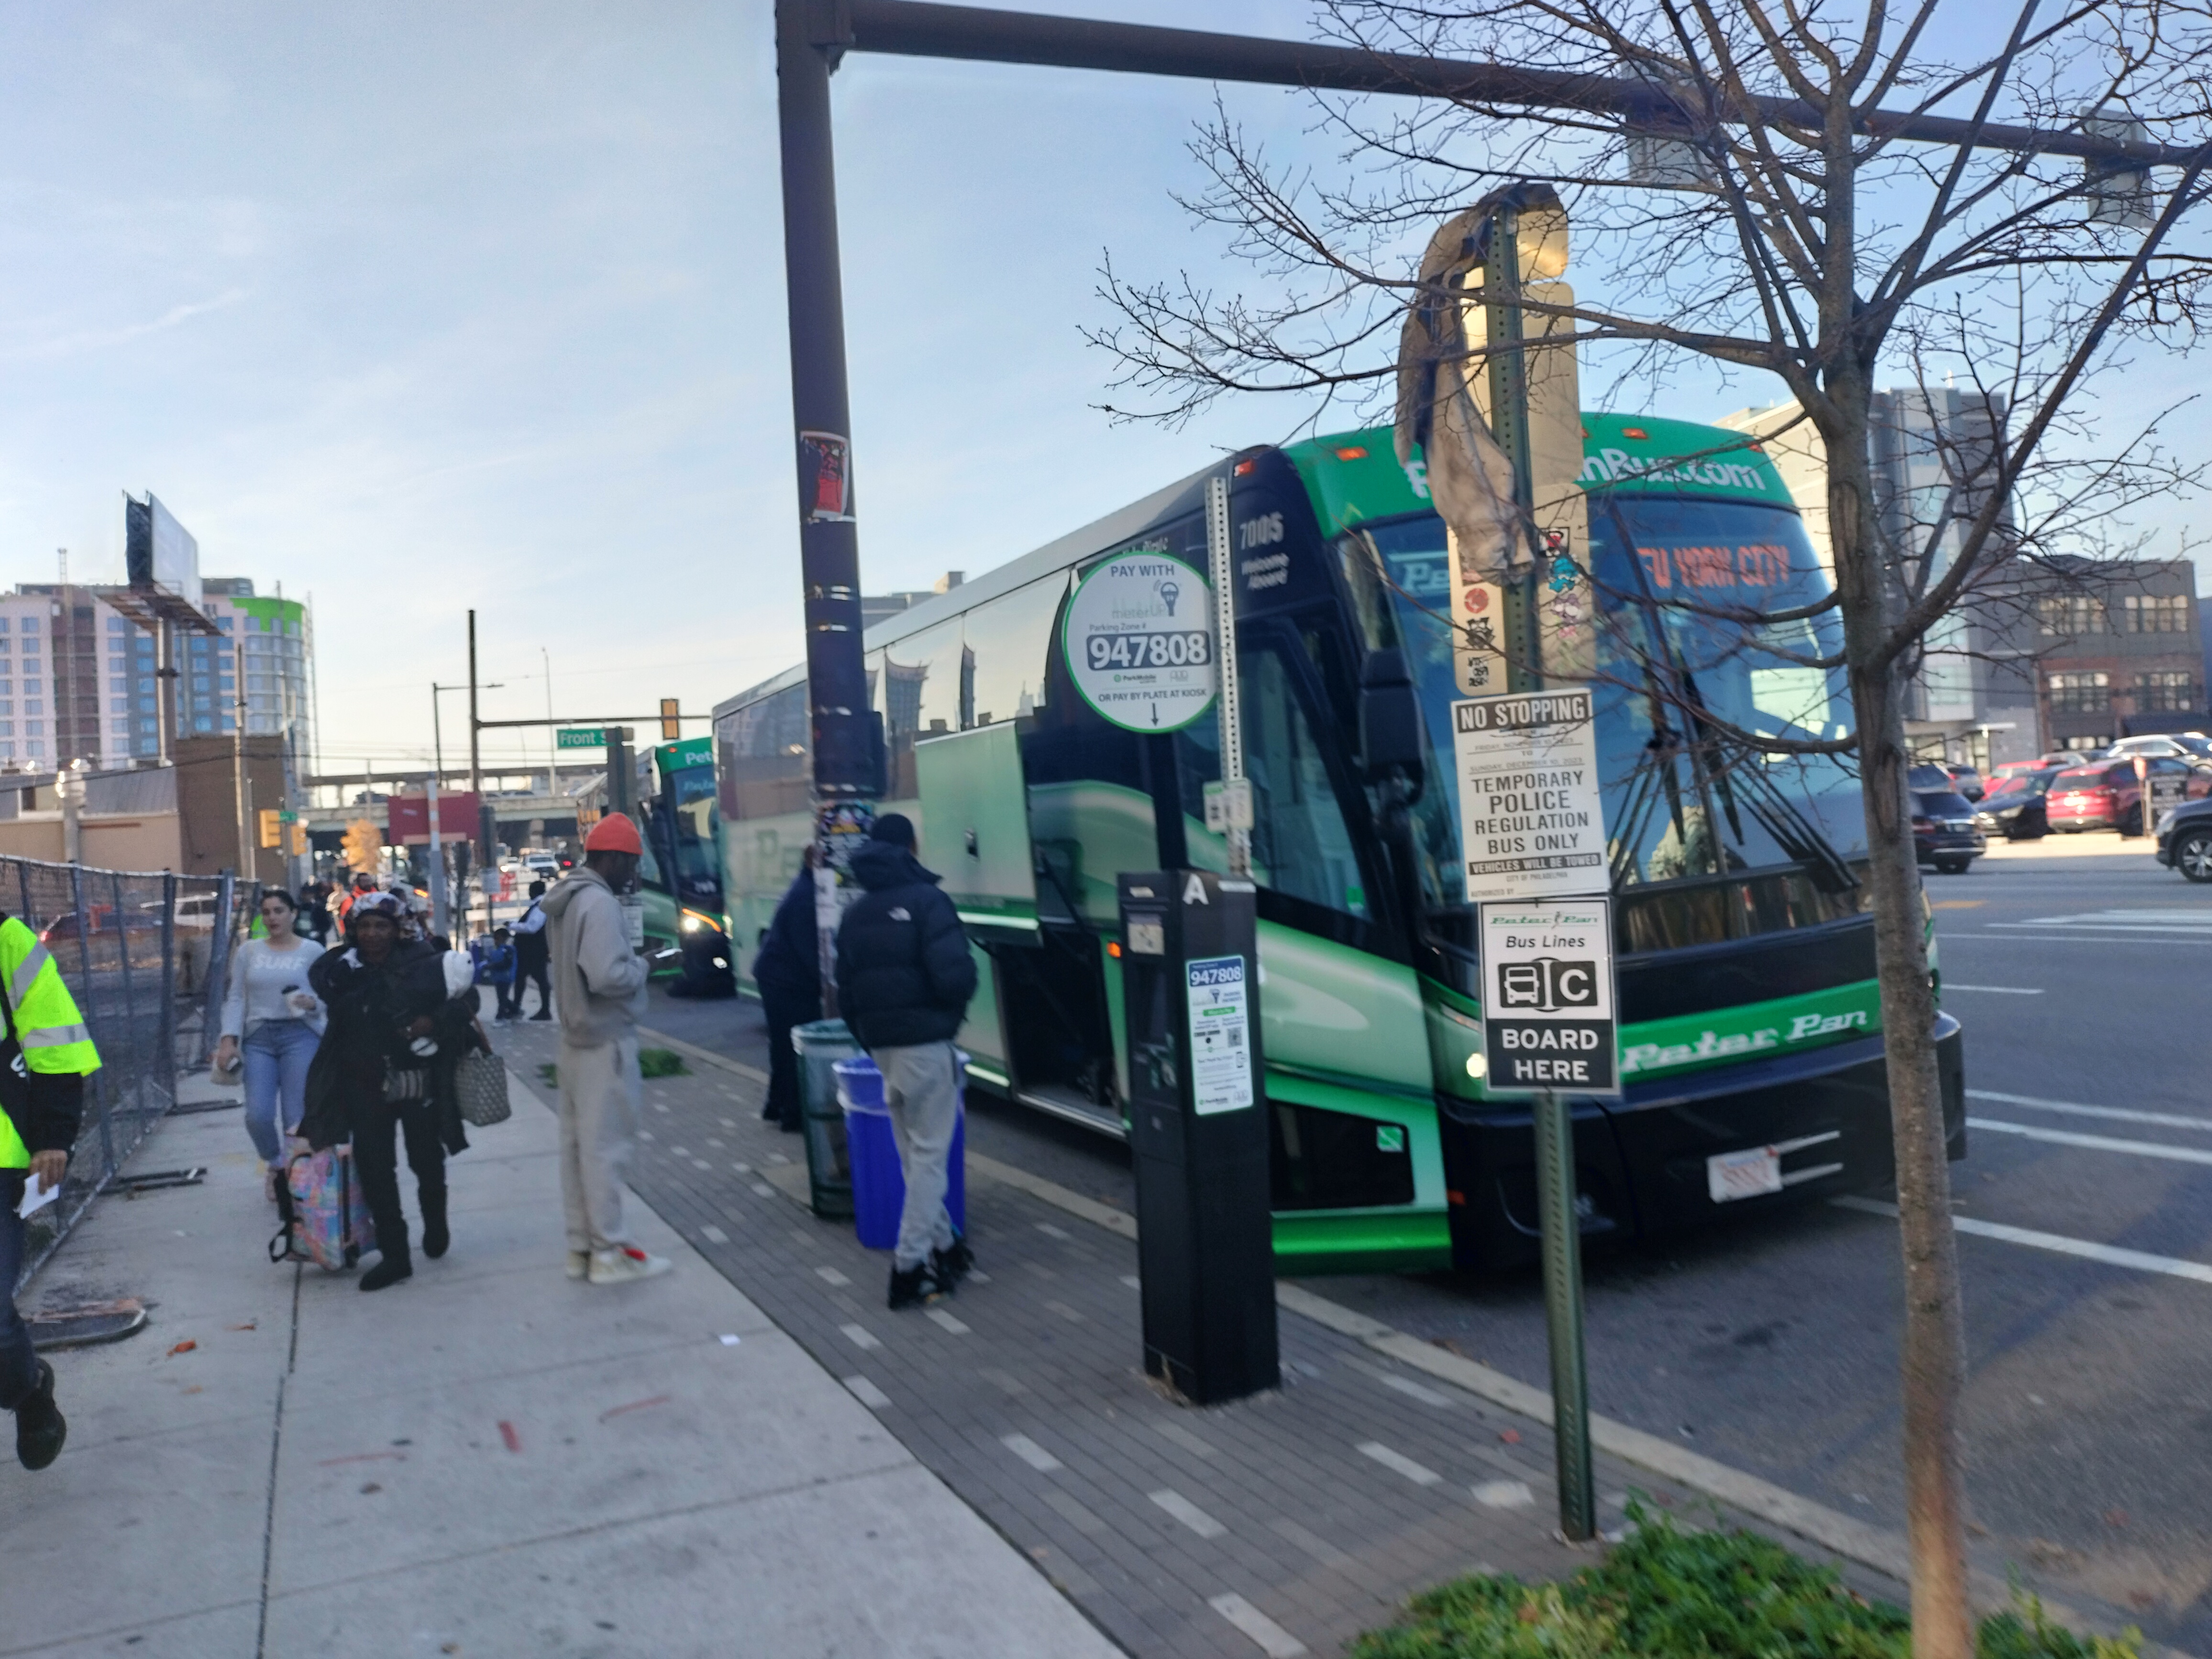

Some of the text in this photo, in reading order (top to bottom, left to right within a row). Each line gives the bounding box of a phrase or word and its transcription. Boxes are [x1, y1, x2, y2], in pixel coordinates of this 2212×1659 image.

[1111, 564, 1174, 577] PAY WITH
[1738, 545, 1790, 586] CITY
[1089, 624, 1118, 633] Parking
[1090, 634, 1206, 669] 947808
[1099, 694, 1111, 702] OR
[1113, 693, 1128, 701] PAY
[1143, 691, 1167, 699] PLATE
[1182, 689, 1206, 697] KIOSK
[1460, 697, 1585, 730] NO STOPPING
[561, 730, 595, 745] Front
[1472, 771, 1584, 793] TEMPORARY
[1490, 790, 1571, 814] POLICE
[1475, 812, 1589, 835] REGULATION
[1488, 833, 1579, 854] BUS ONLY
[1472, 854, 1600, 874] VEHICLES WILL BE TOWED
[1183, 874, 1208, 905] A
[1492, 916, 1552, 925] Peter
[1506, 935, 1585, 948] Bus Lines
[1191, 965, 1242, 986] 947808
[1559, 969, 1590, 1002] C
[1502, 1028, 1599, 1051] BOARD
[1620, 1011, 1867, 1072] Peter Pan
[1514, 1059, 1590, 1081] HERE
